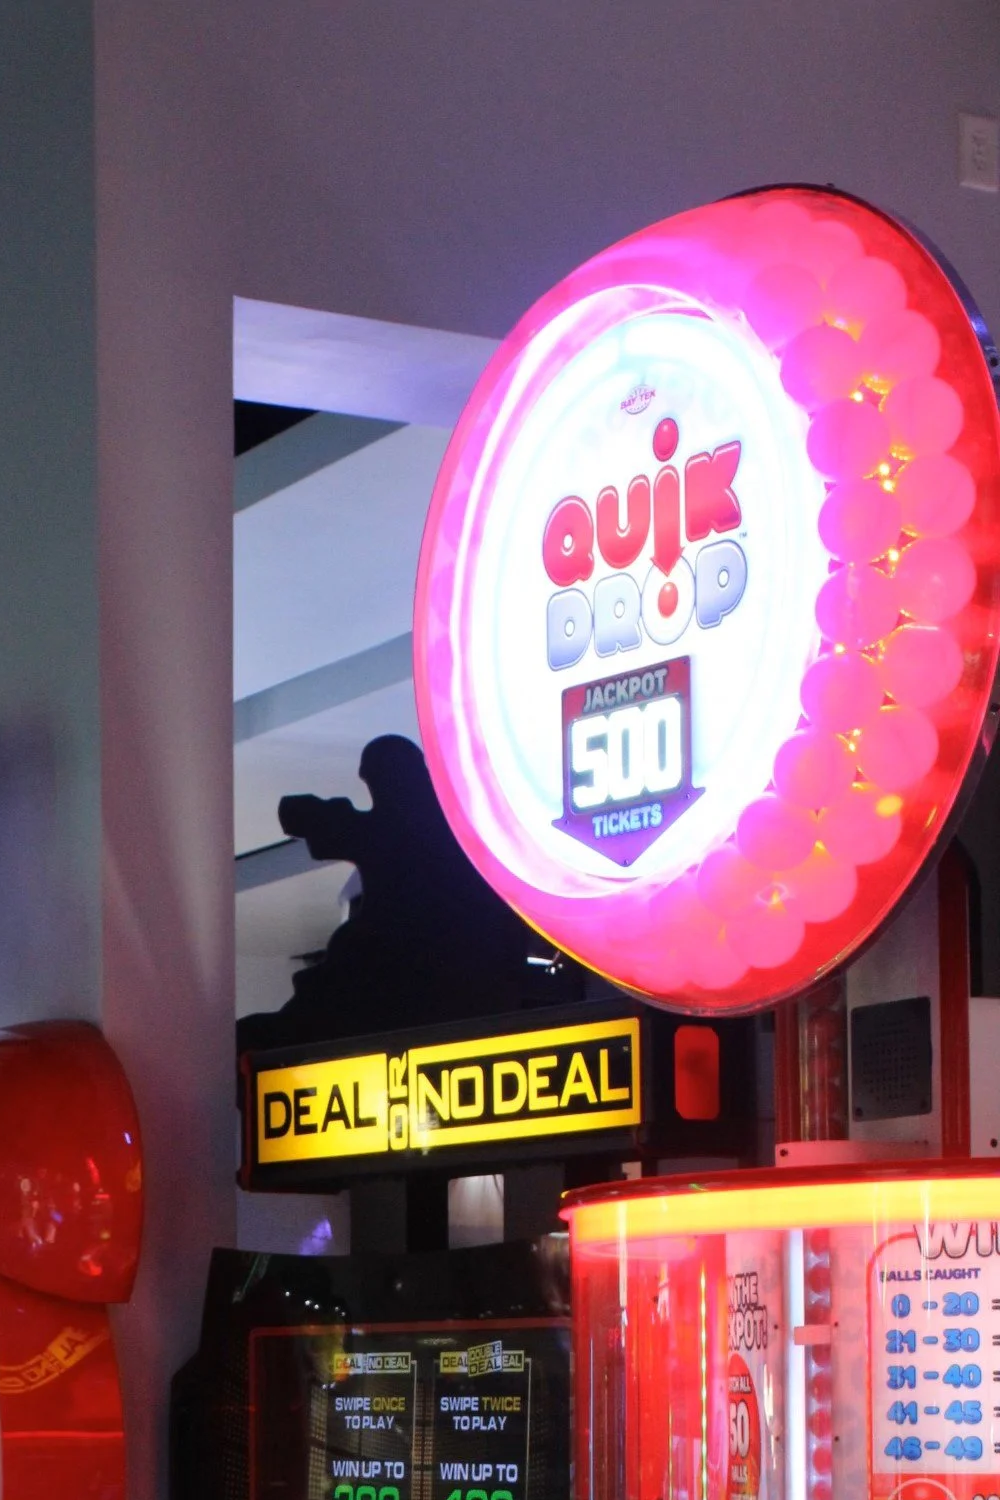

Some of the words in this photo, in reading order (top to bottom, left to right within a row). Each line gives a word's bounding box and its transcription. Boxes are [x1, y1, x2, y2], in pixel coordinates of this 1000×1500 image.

[542, 417, 742, 587] QUIK
[546, 539, 748, 672] DROP
[582, 668, 668, 713] JACKPOT
[571, 697, 682, 808] 500
[592, 803, 662, 839] TICKETS
[264, 1080, 378, 1140] DEAL
[388, 1051, 408, 1150] OR
[417, 1065, 484, 1123] NO
[493, 1048, 629, 1115] DEAL
[926, 1267, 981, 1280] CAUGHT
[735, 1272, 758, 1306] THE
[891, 1293, 911, 1318] 0
[942, 1291, 980, 1317] 20
[886, 1329, 917, 1354] 21
[943, 1327, 980, 1353] 30
[384, 1355, 409, 1369] DEAL
[503, 1353, 521, 1367] EAL
[887, 1365, 917, 1389] 31
[943, 1364, 982, 1388] 40
[335, 1396, 371, 1412] SWIPE
[373, 1396, 406, 1412] ONCE
[440, 1396, 479, 1412] SWIPE
[482, 1396, 521, 1412] TWICE
[887, 1401, 918, 1425] 41
[944, 1400, 983, 1425] 45
[345, 1415, 361, 1430] TO
[362, 1416, 394, 1430] PLAY
[453, 1416, 471, 1431] TO
[472, 1416, 507, 1431] PLAY
[884, 1436, 922, 1461] 46
[944, 1436, 983, 1461] 49
[333, 1460, 360, 1477] WIN
[362, 1461, 380, 1477] UP
[384, 1462, 404, 1479] TO
[440, 1463, 468, 1481] WIN
[471, 1463, 491, 1481] UP
[496, 1464, 518, 1483] TO
